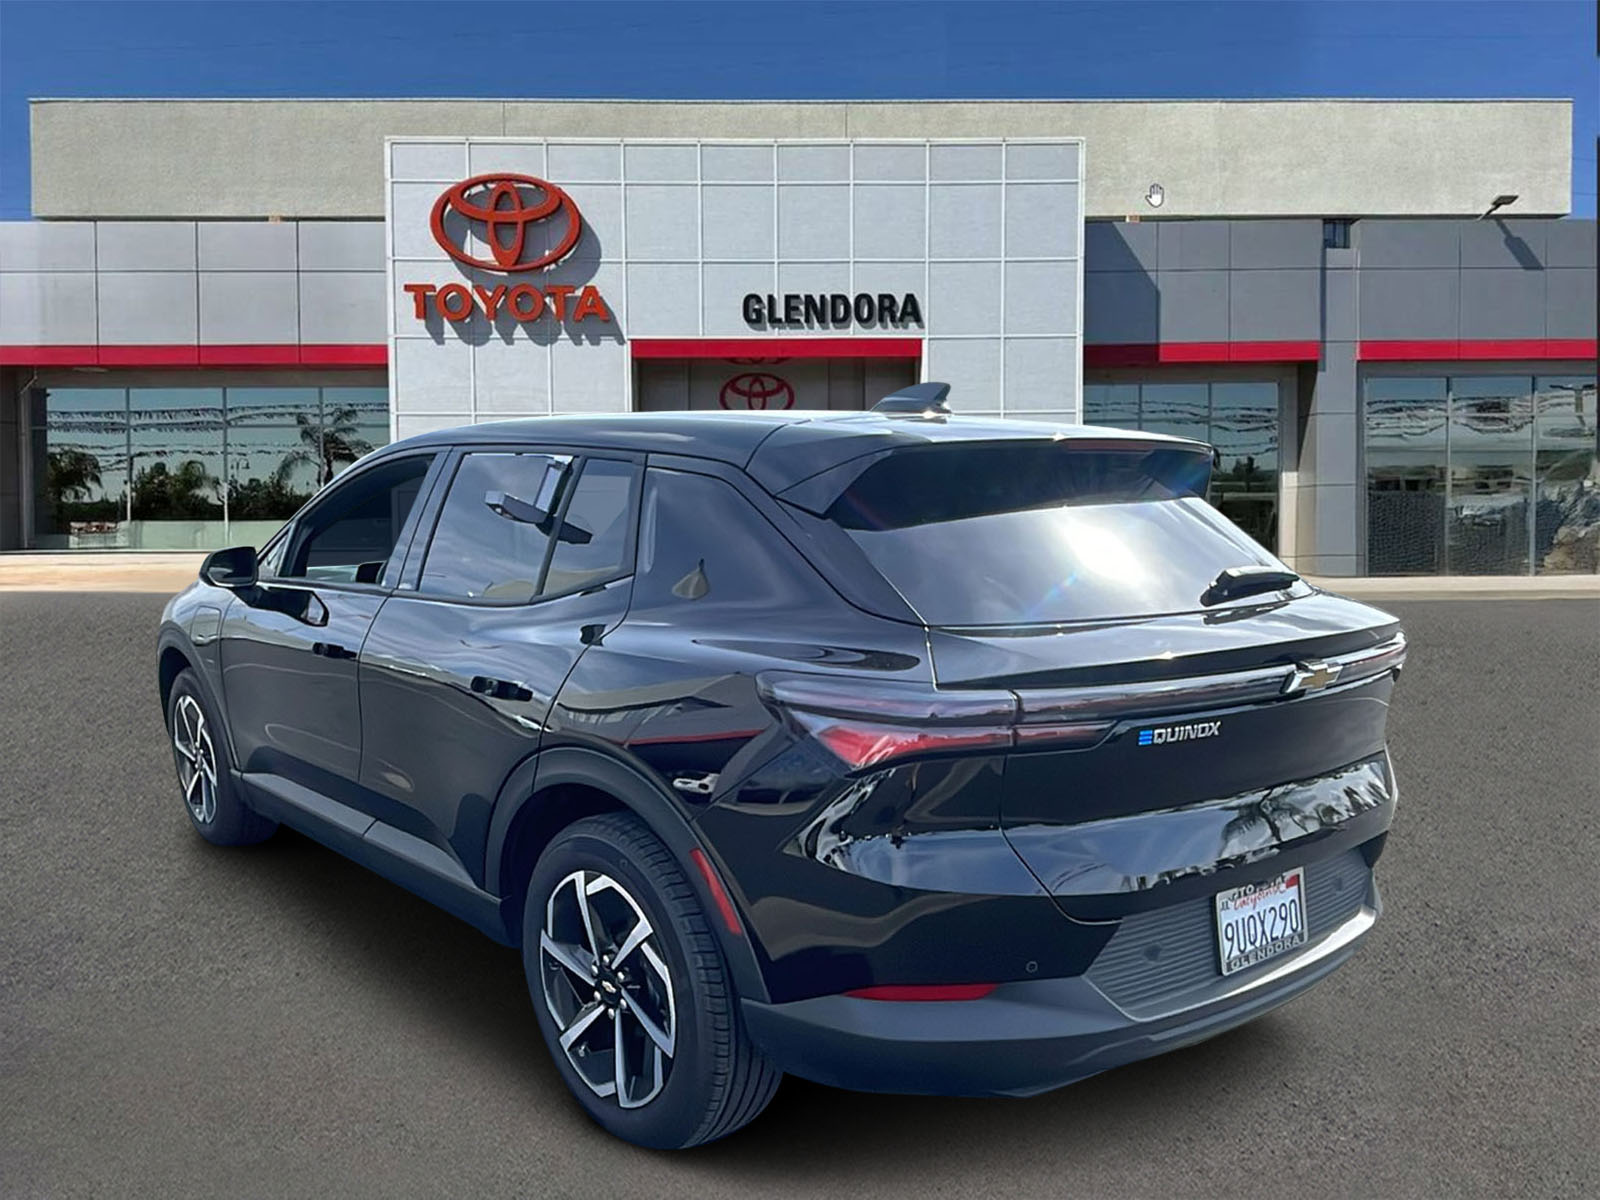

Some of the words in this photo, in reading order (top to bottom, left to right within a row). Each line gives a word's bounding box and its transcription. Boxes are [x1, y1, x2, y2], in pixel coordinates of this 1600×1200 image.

[403, 282, 611, 322] TOYOTA
[742, 292, 923, 326] GLENDORA
[1138, 721, 1221, 746] EQUINOX
[1224, 898, 1299, 960] 9UQX290
[1230, 934, 1300, 970] GLENDORA
